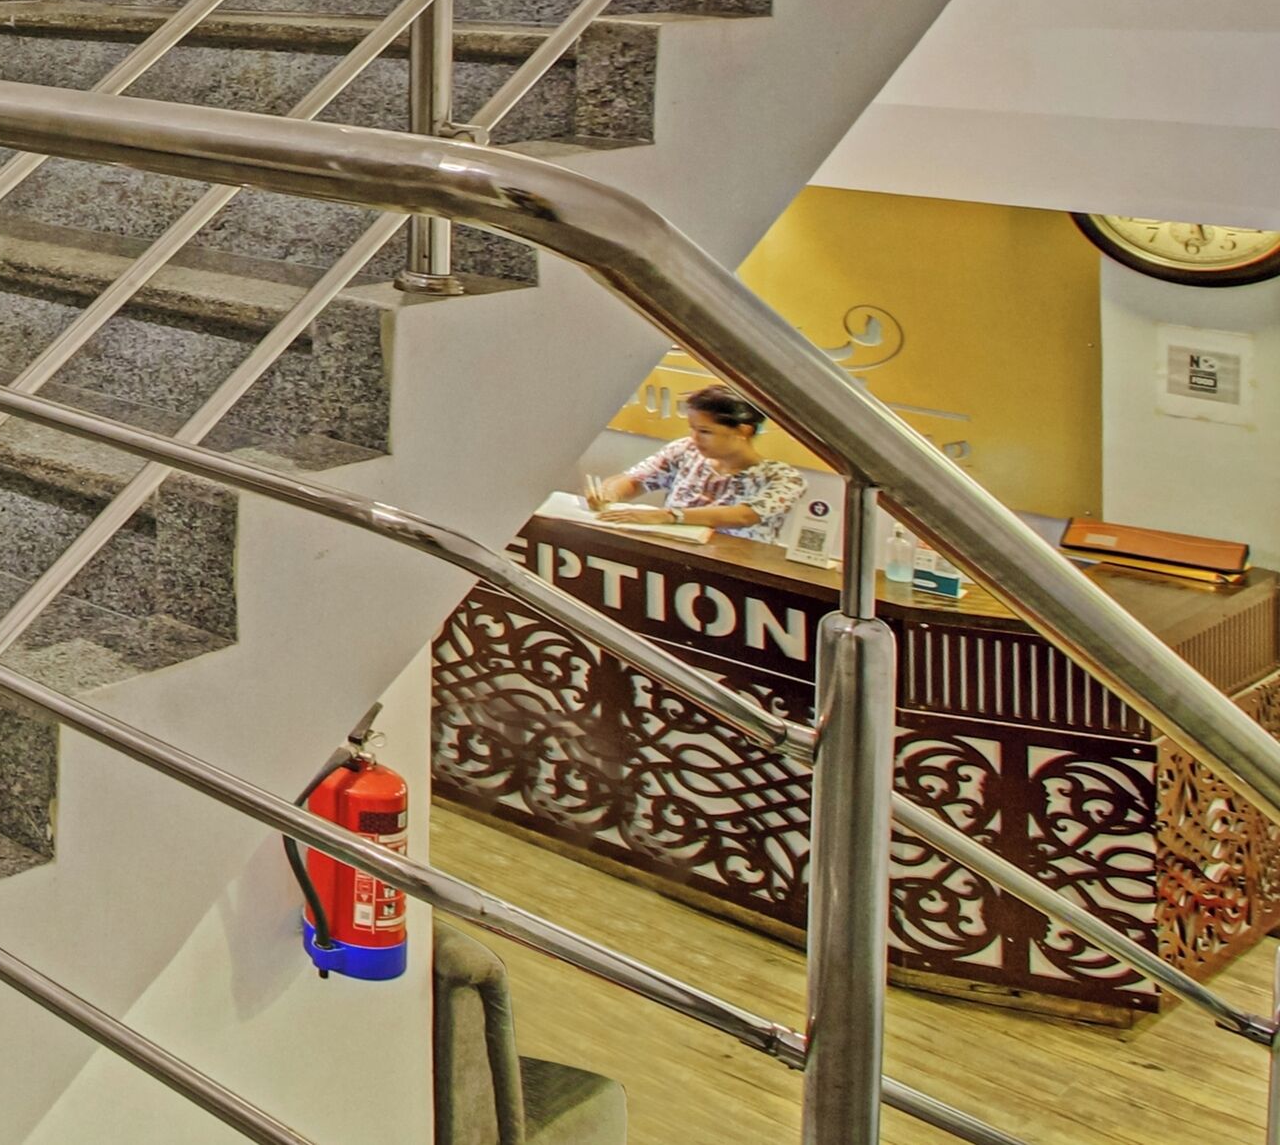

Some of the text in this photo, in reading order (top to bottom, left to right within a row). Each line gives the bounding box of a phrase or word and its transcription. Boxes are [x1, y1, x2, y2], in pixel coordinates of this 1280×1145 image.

[1146, 226, 1160, 243] 7
[1220, 233, 1237, 251] 5
[1184, 237, 1201, 254] 6
